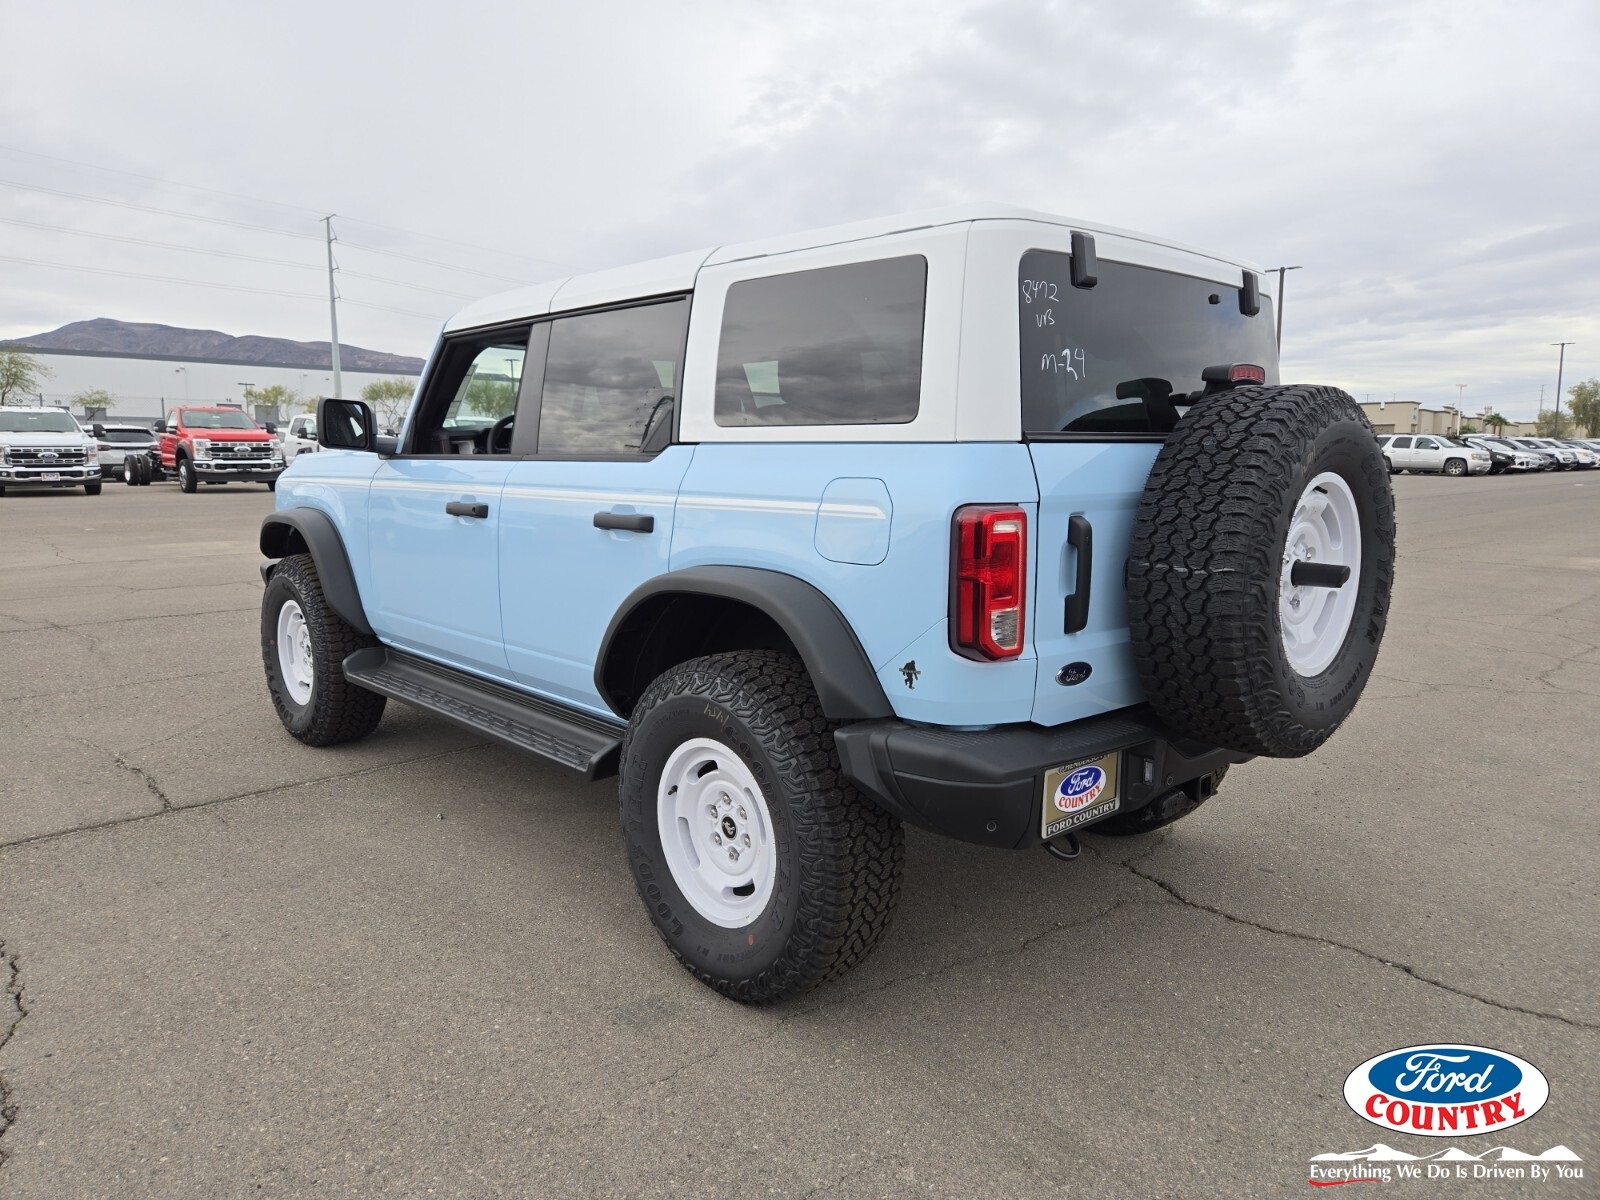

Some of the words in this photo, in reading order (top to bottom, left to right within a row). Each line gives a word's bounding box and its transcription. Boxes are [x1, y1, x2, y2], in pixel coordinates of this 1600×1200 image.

[1022, 279, 1060, 304] 8472
[1068, 769, 1095, 795] Ford
[1058, 783, 1103, 809] COUNTRY
[1047, 819, 1073, 836] FORD
[1073, 801, 1115, 826] COUNTRY
